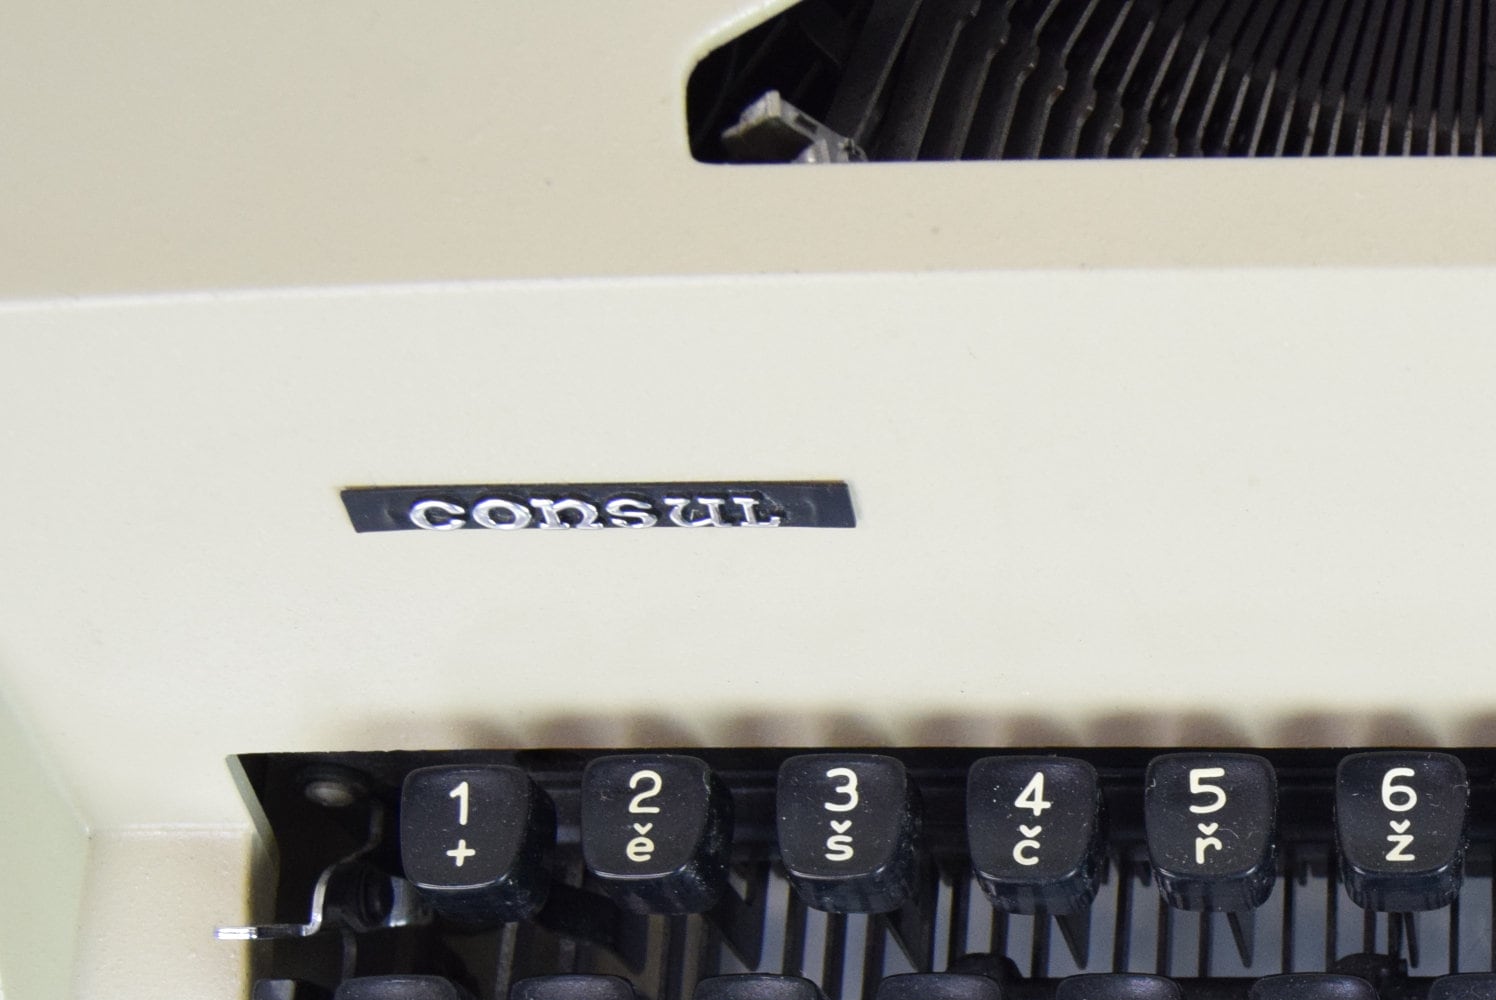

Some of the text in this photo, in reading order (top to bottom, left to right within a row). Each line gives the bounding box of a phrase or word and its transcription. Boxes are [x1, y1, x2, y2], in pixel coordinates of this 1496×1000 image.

[449, 780, 469, 826] 1
[628, 769, 663, 814] 2
[823, 767, 859, 812] 3
[1014, 771, 1052, 817] 4
[1188, 767, 1227, 814] 5
[1381, 767, 1418, 812] 6
[446, 838, 476, 867] +
[823, 819, 855, 862] š
[1012, 824, 1042, 867] č
[1385, 819, 1416, 862] ž
